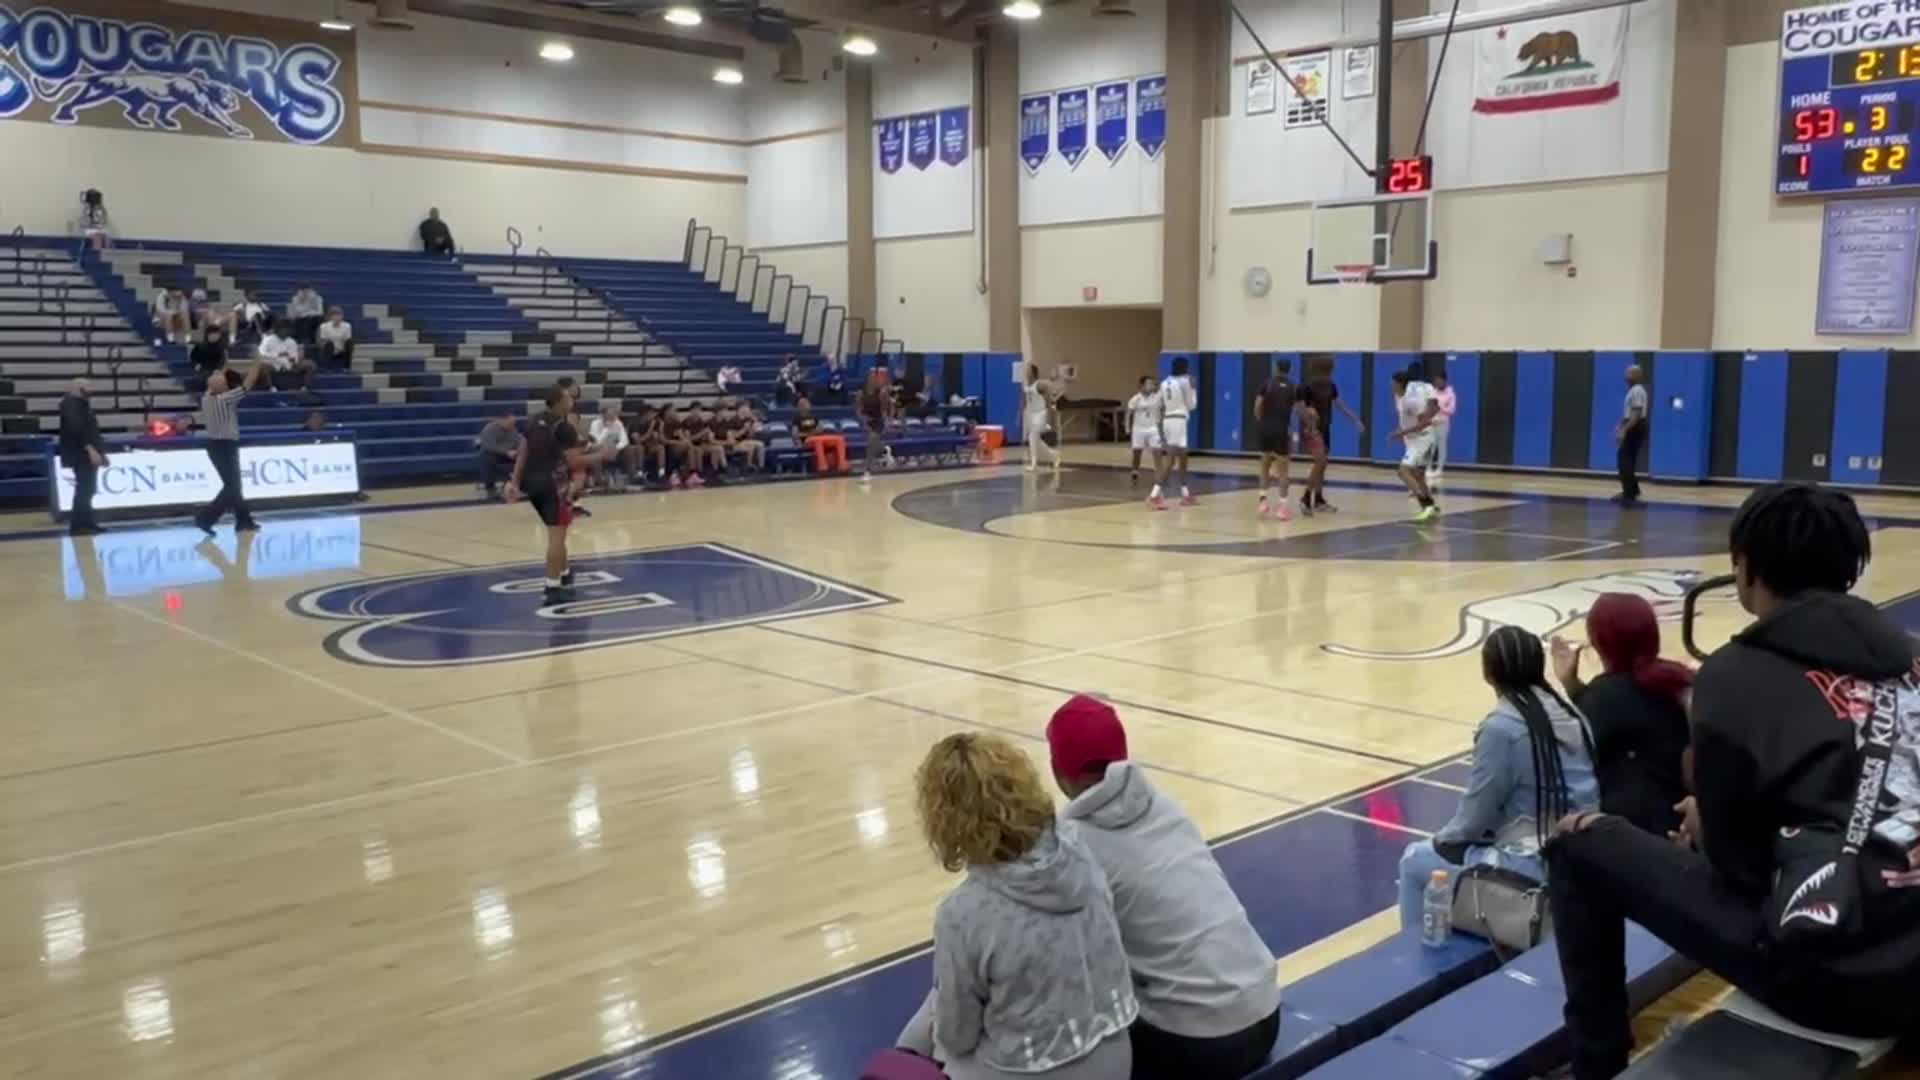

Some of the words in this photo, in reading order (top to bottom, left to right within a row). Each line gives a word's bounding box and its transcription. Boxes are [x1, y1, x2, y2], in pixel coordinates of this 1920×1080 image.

[1787, 8, 1850, 29] HOME
[1856, 2, 1888, 19] OF
[1791, 91, 1832, 109] HOME
[1795, 108, 1836, 140] 53
[1871, 106, 1886, 131] 3
[1800, 155, 1807, 175] 1
[1390, 161, 1422, 192] 25
[162, 471, 206, 483] BANK
[312, 463, 353, 475] BANK
